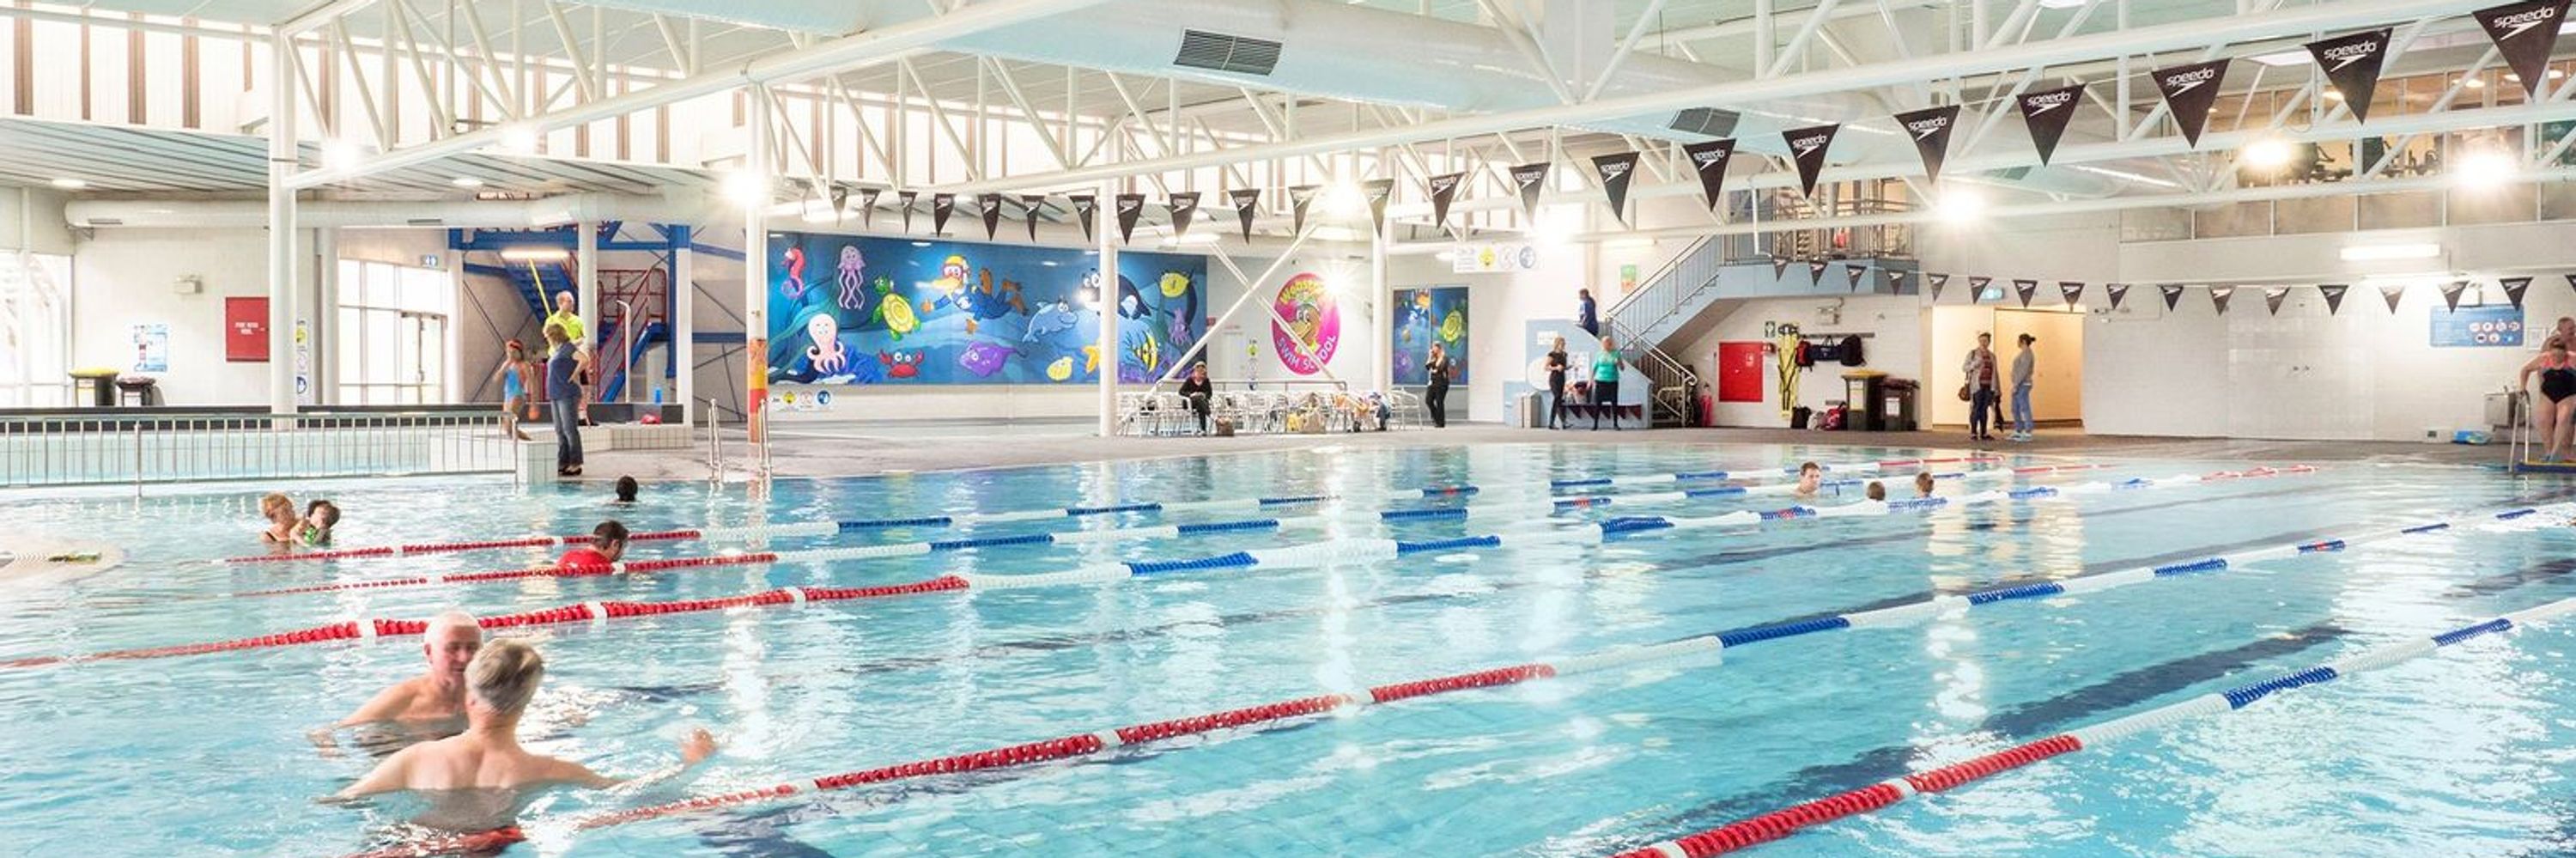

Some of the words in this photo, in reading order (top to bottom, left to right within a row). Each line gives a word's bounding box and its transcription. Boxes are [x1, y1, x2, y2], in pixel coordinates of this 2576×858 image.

[2494, 7, 2555, 27] speedo
[2324, 41, 2378, 59] speedo
[2166, 68, 2215, 87] speedo
[2027, 92, 2071, 108] speedo
[1909, 117, 1947, 131] speedo
[1793, 134, 1827, 149] speedo
[1693, 149, 1726, 161] speedo
